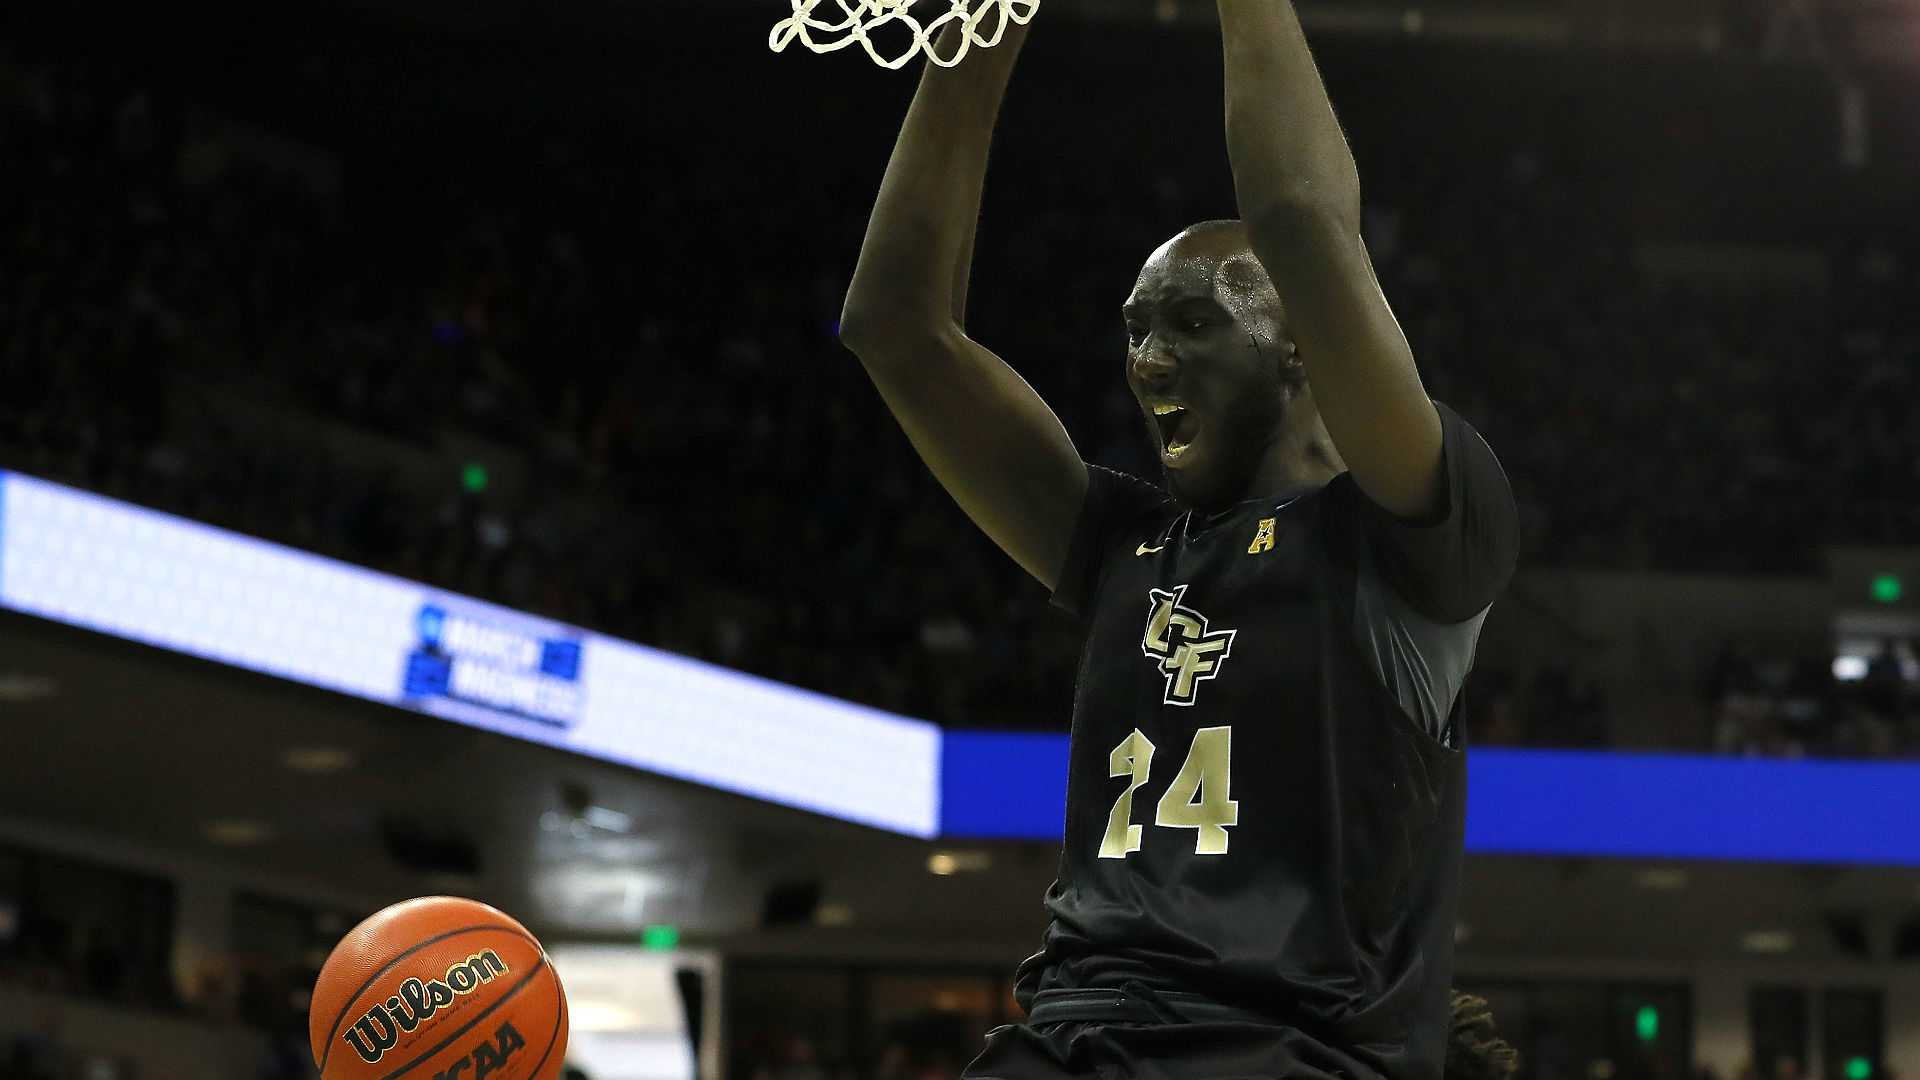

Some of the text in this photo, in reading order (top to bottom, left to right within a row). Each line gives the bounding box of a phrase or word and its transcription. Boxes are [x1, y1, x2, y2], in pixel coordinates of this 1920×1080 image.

[1098, 725, 1238, 859] 24
[342, 947, 509, 1064] Wilson
[432, 1020, 525, 1080] CAA
